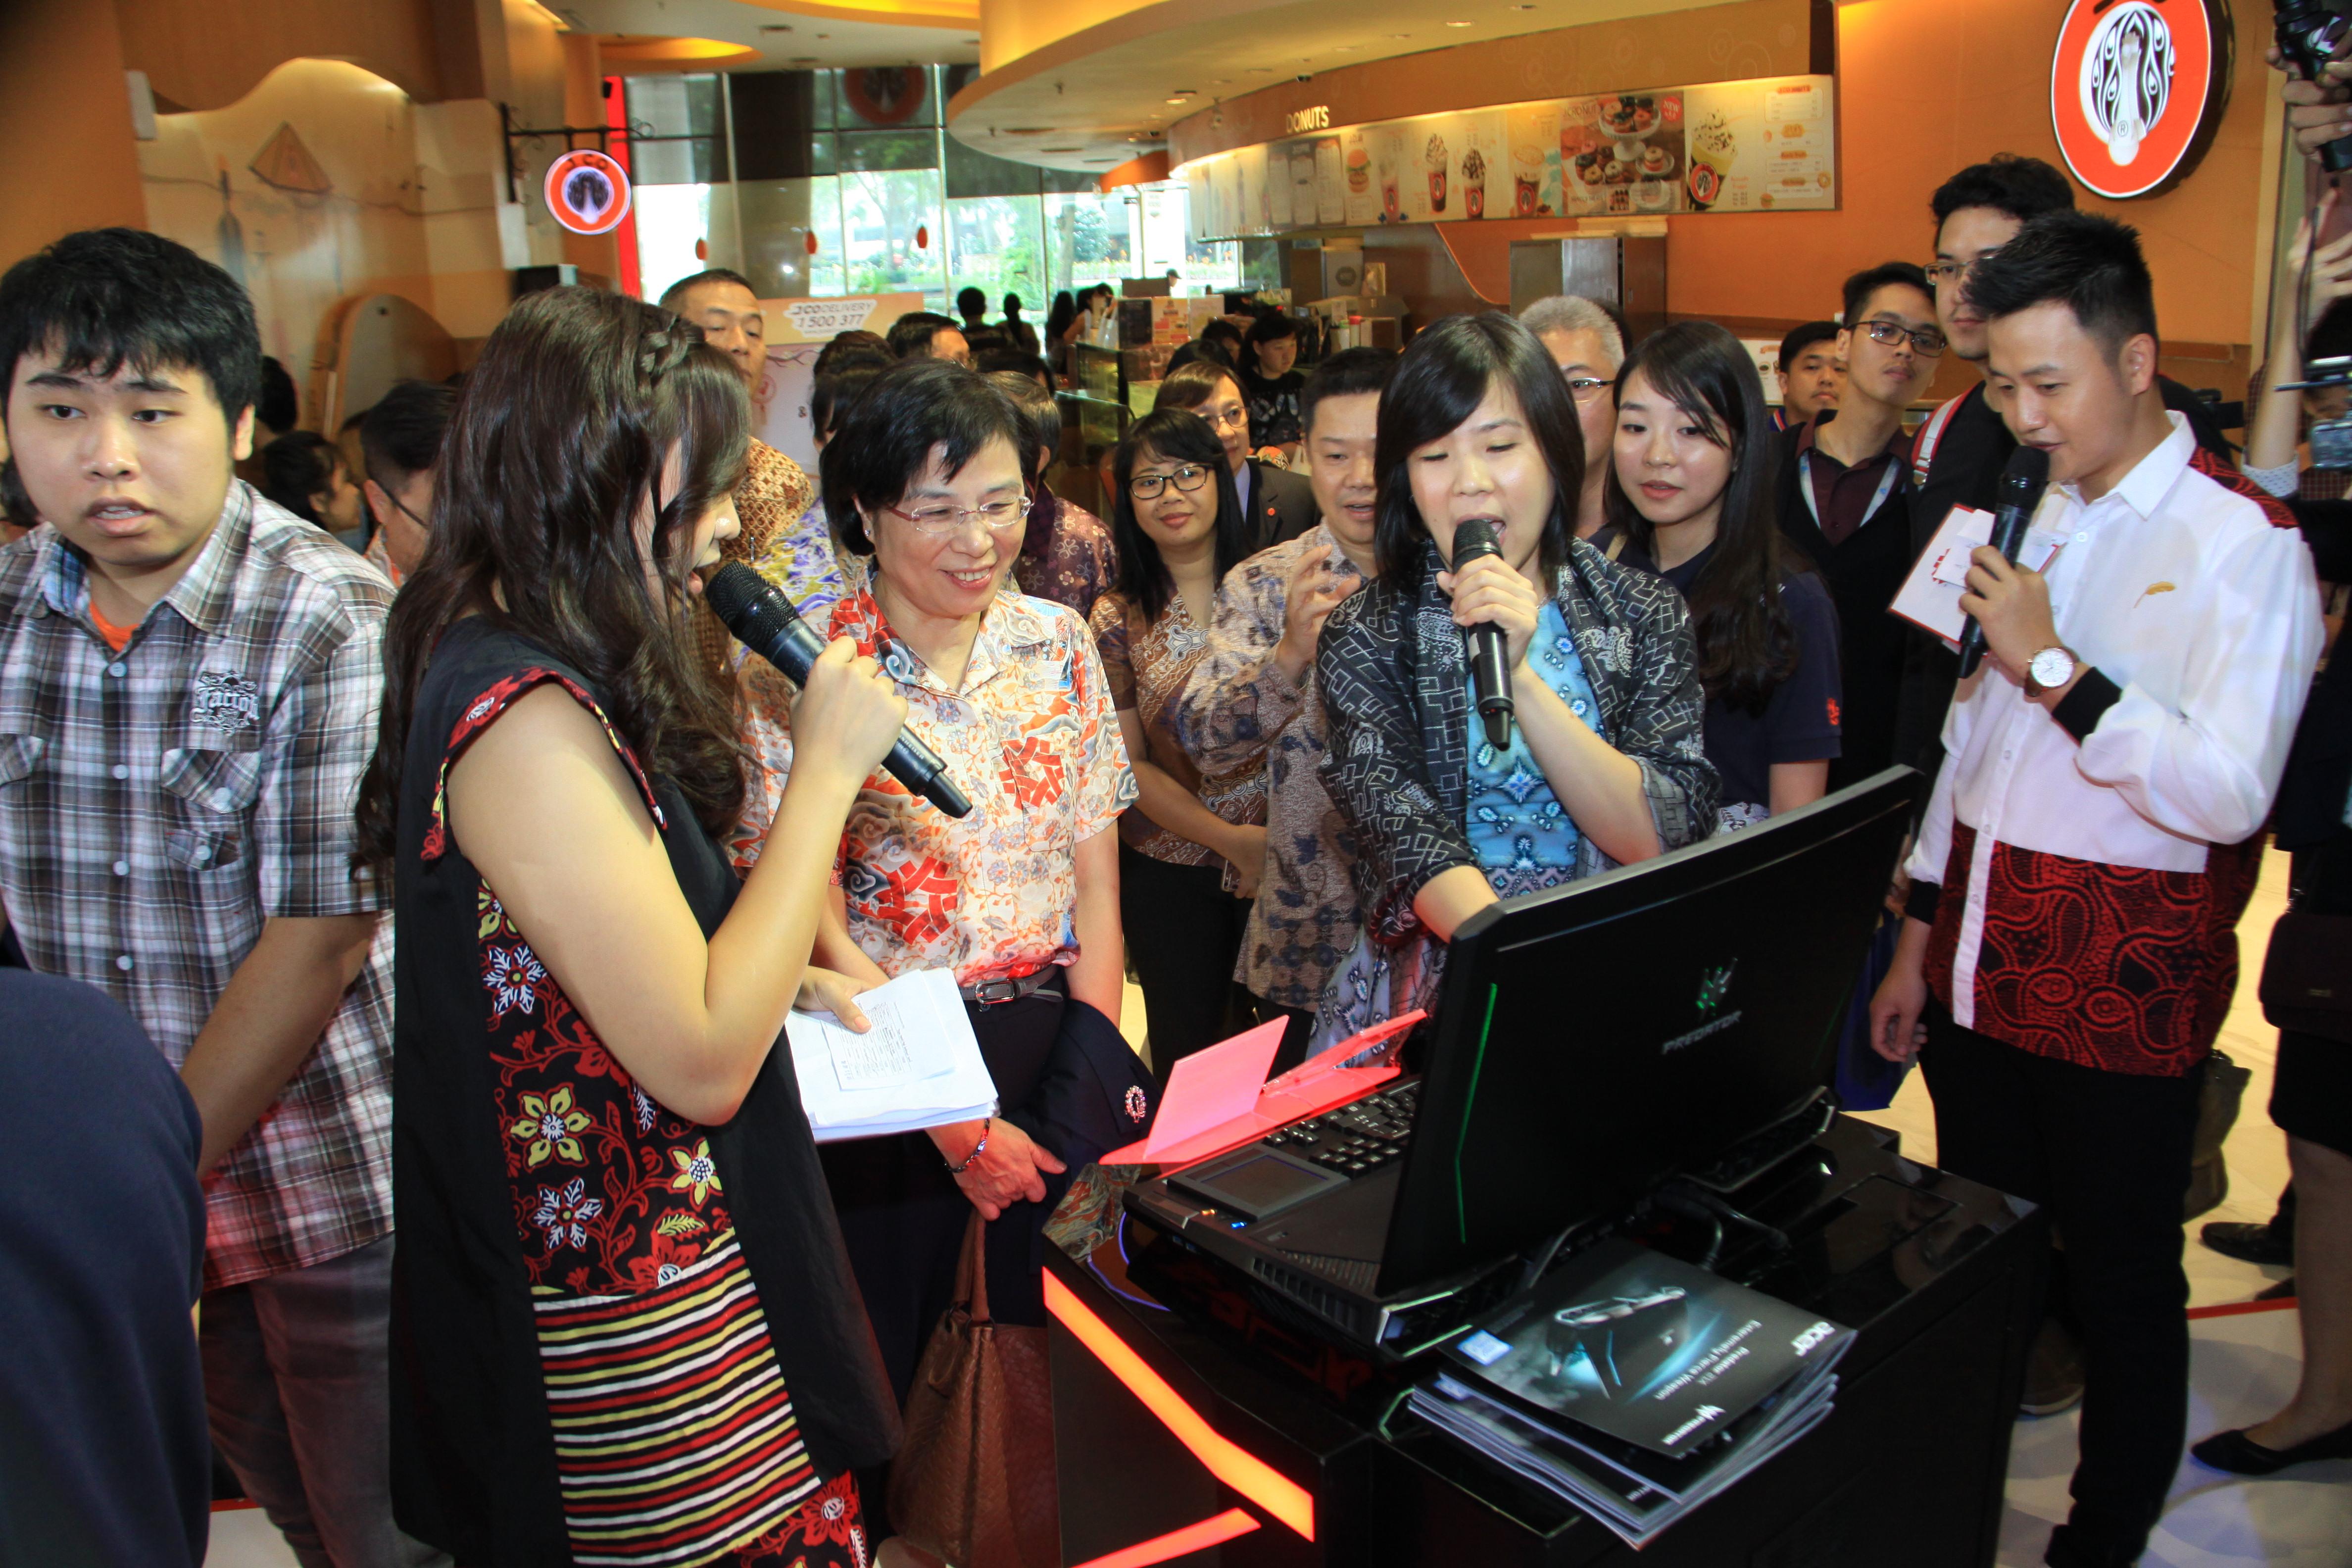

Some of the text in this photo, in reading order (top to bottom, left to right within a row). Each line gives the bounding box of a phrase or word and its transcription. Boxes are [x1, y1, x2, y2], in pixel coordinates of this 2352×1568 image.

[1286, 105, 1329, 134] DONUTS
[808, 316, 835, 327] 500
[840, 314, 863, 325] 377
[1791, 1322, 1835, 1357] acer
[1688, 1353, 1719, 1374] Fierce
[1712, 1346, 1750, 1374] Predator
[1653, 1374, 1694, 1400] Weapon
